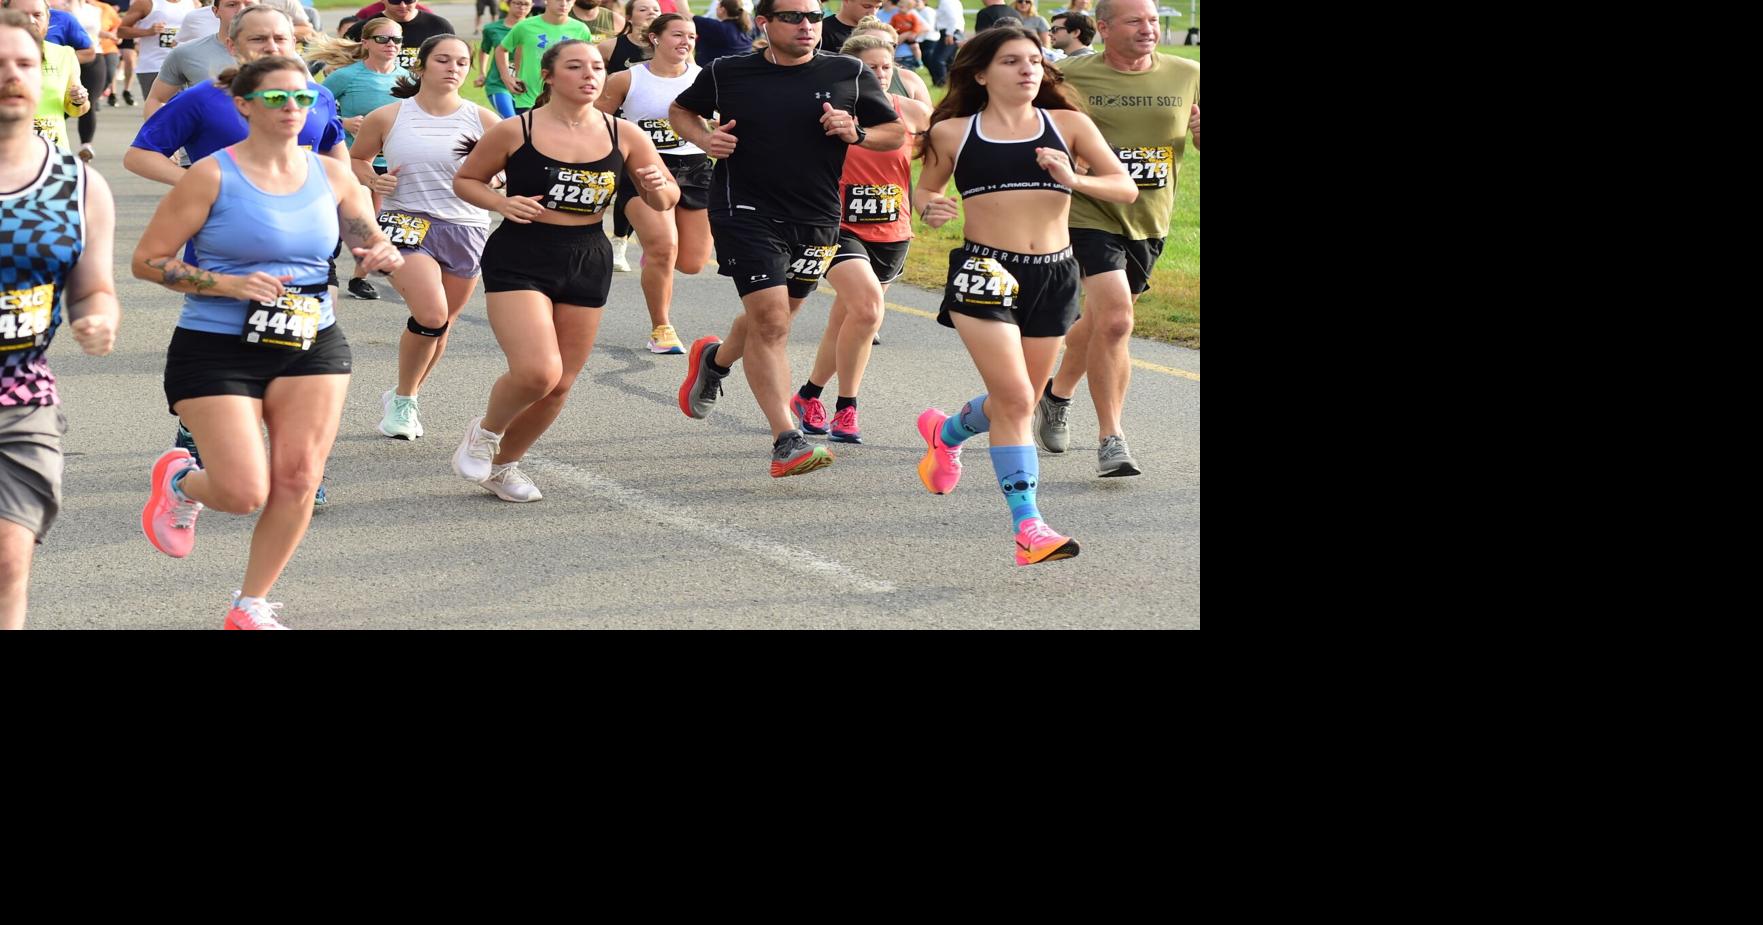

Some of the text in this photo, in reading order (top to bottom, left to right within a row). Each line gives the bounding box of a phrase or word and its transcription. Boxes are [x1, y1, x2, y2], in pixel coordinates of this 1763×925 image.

[1156, 96, 1183, 107] SOZO
[643, 120, 671, 129] GCX
[1119, 150, 1167, 160] GCXC
[558, 171, 609, 186] GCXC
[549, 183, 609, 205] 4287
[852, 186, 897, 196] GCXC
[962, 186, 985, 196] UNDER
[849, 198, 896, 214] 4411
[379, 213, 425, 229] GCXC
[791, 258, 824, 275] 423
[248, 309, 316, 340] 4446
